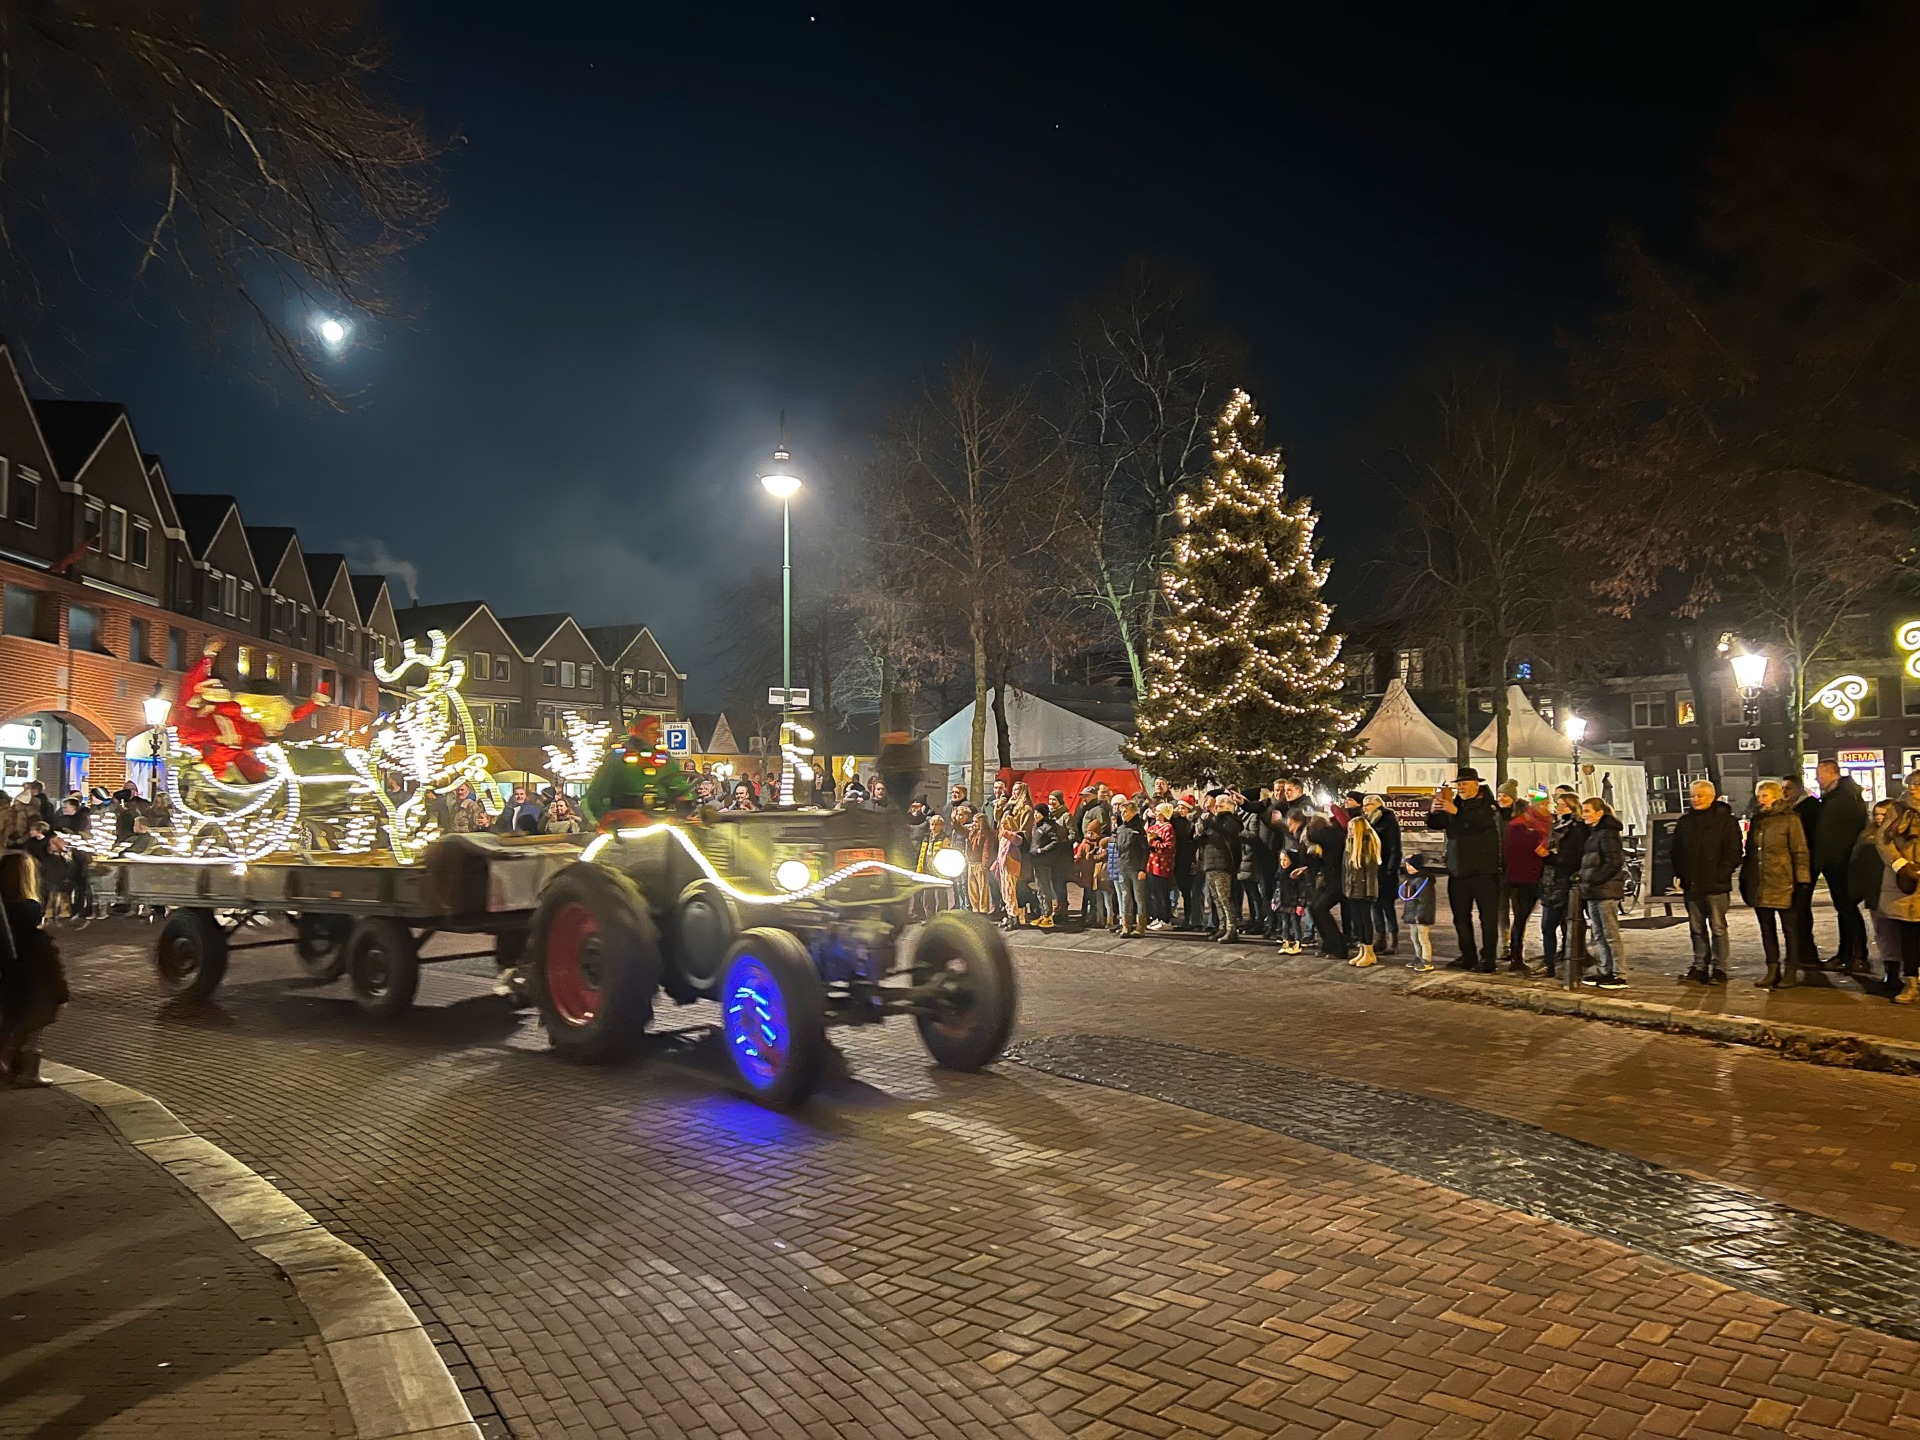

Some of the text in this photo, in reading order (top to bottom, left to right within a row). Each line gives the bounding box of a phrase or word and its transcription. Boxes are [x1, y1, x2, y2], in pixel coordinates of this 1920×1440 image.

[671, 731, 683, 748] P
[1842, 752, 1877, 762] HEMA
[1384, 800, 1420, 808] nteren
[1394, 809, 1429, 818] stsfee
